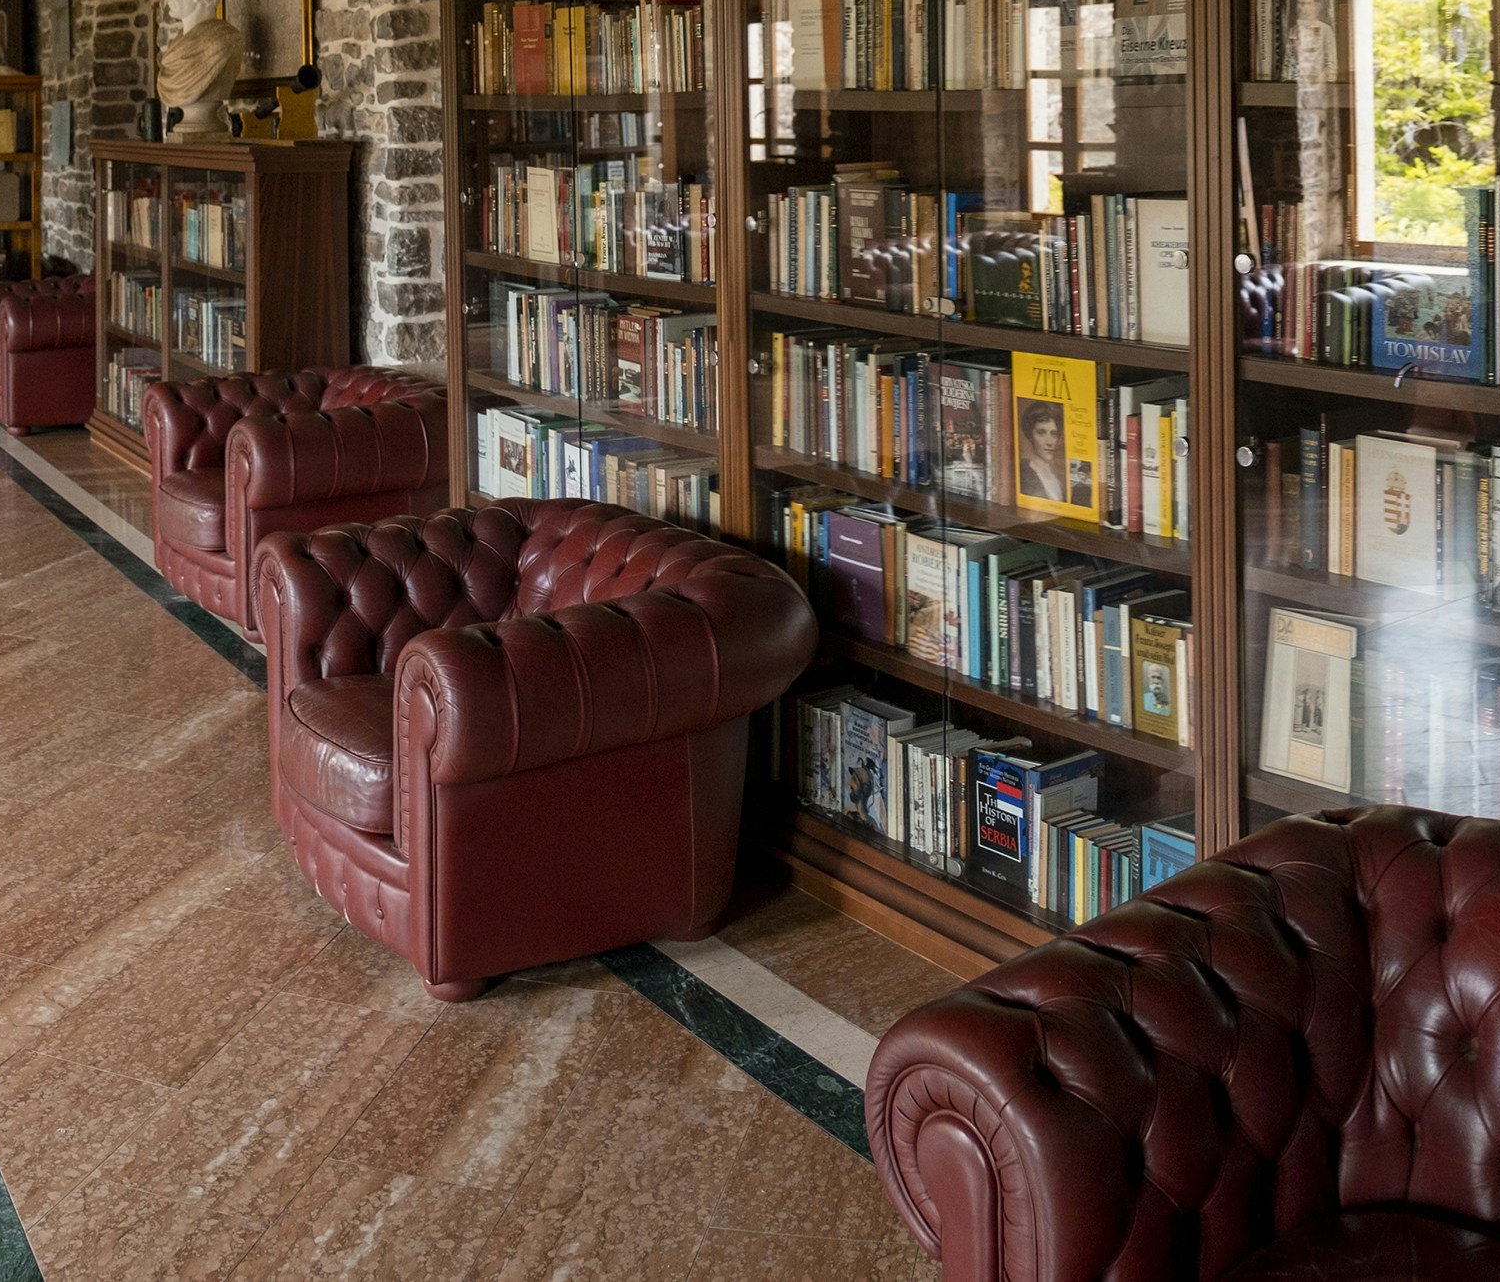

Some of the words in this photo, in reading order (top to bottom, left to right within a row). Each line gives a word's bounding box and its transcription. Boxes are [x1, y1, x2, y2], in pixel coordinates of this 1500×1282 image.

[1122, 39, 1155, 52] Eiserne
[1159, 38, 1187, 50] Kreuz
[1384, 341, 1471, 364] TOMISLAV
[1033, 367, 1071, 400] ZITA
[980, 803, 1017, 825] HISTORY
[986, 816, 995, 826] OF
[981, 826, 1017, 851] SERBIA
